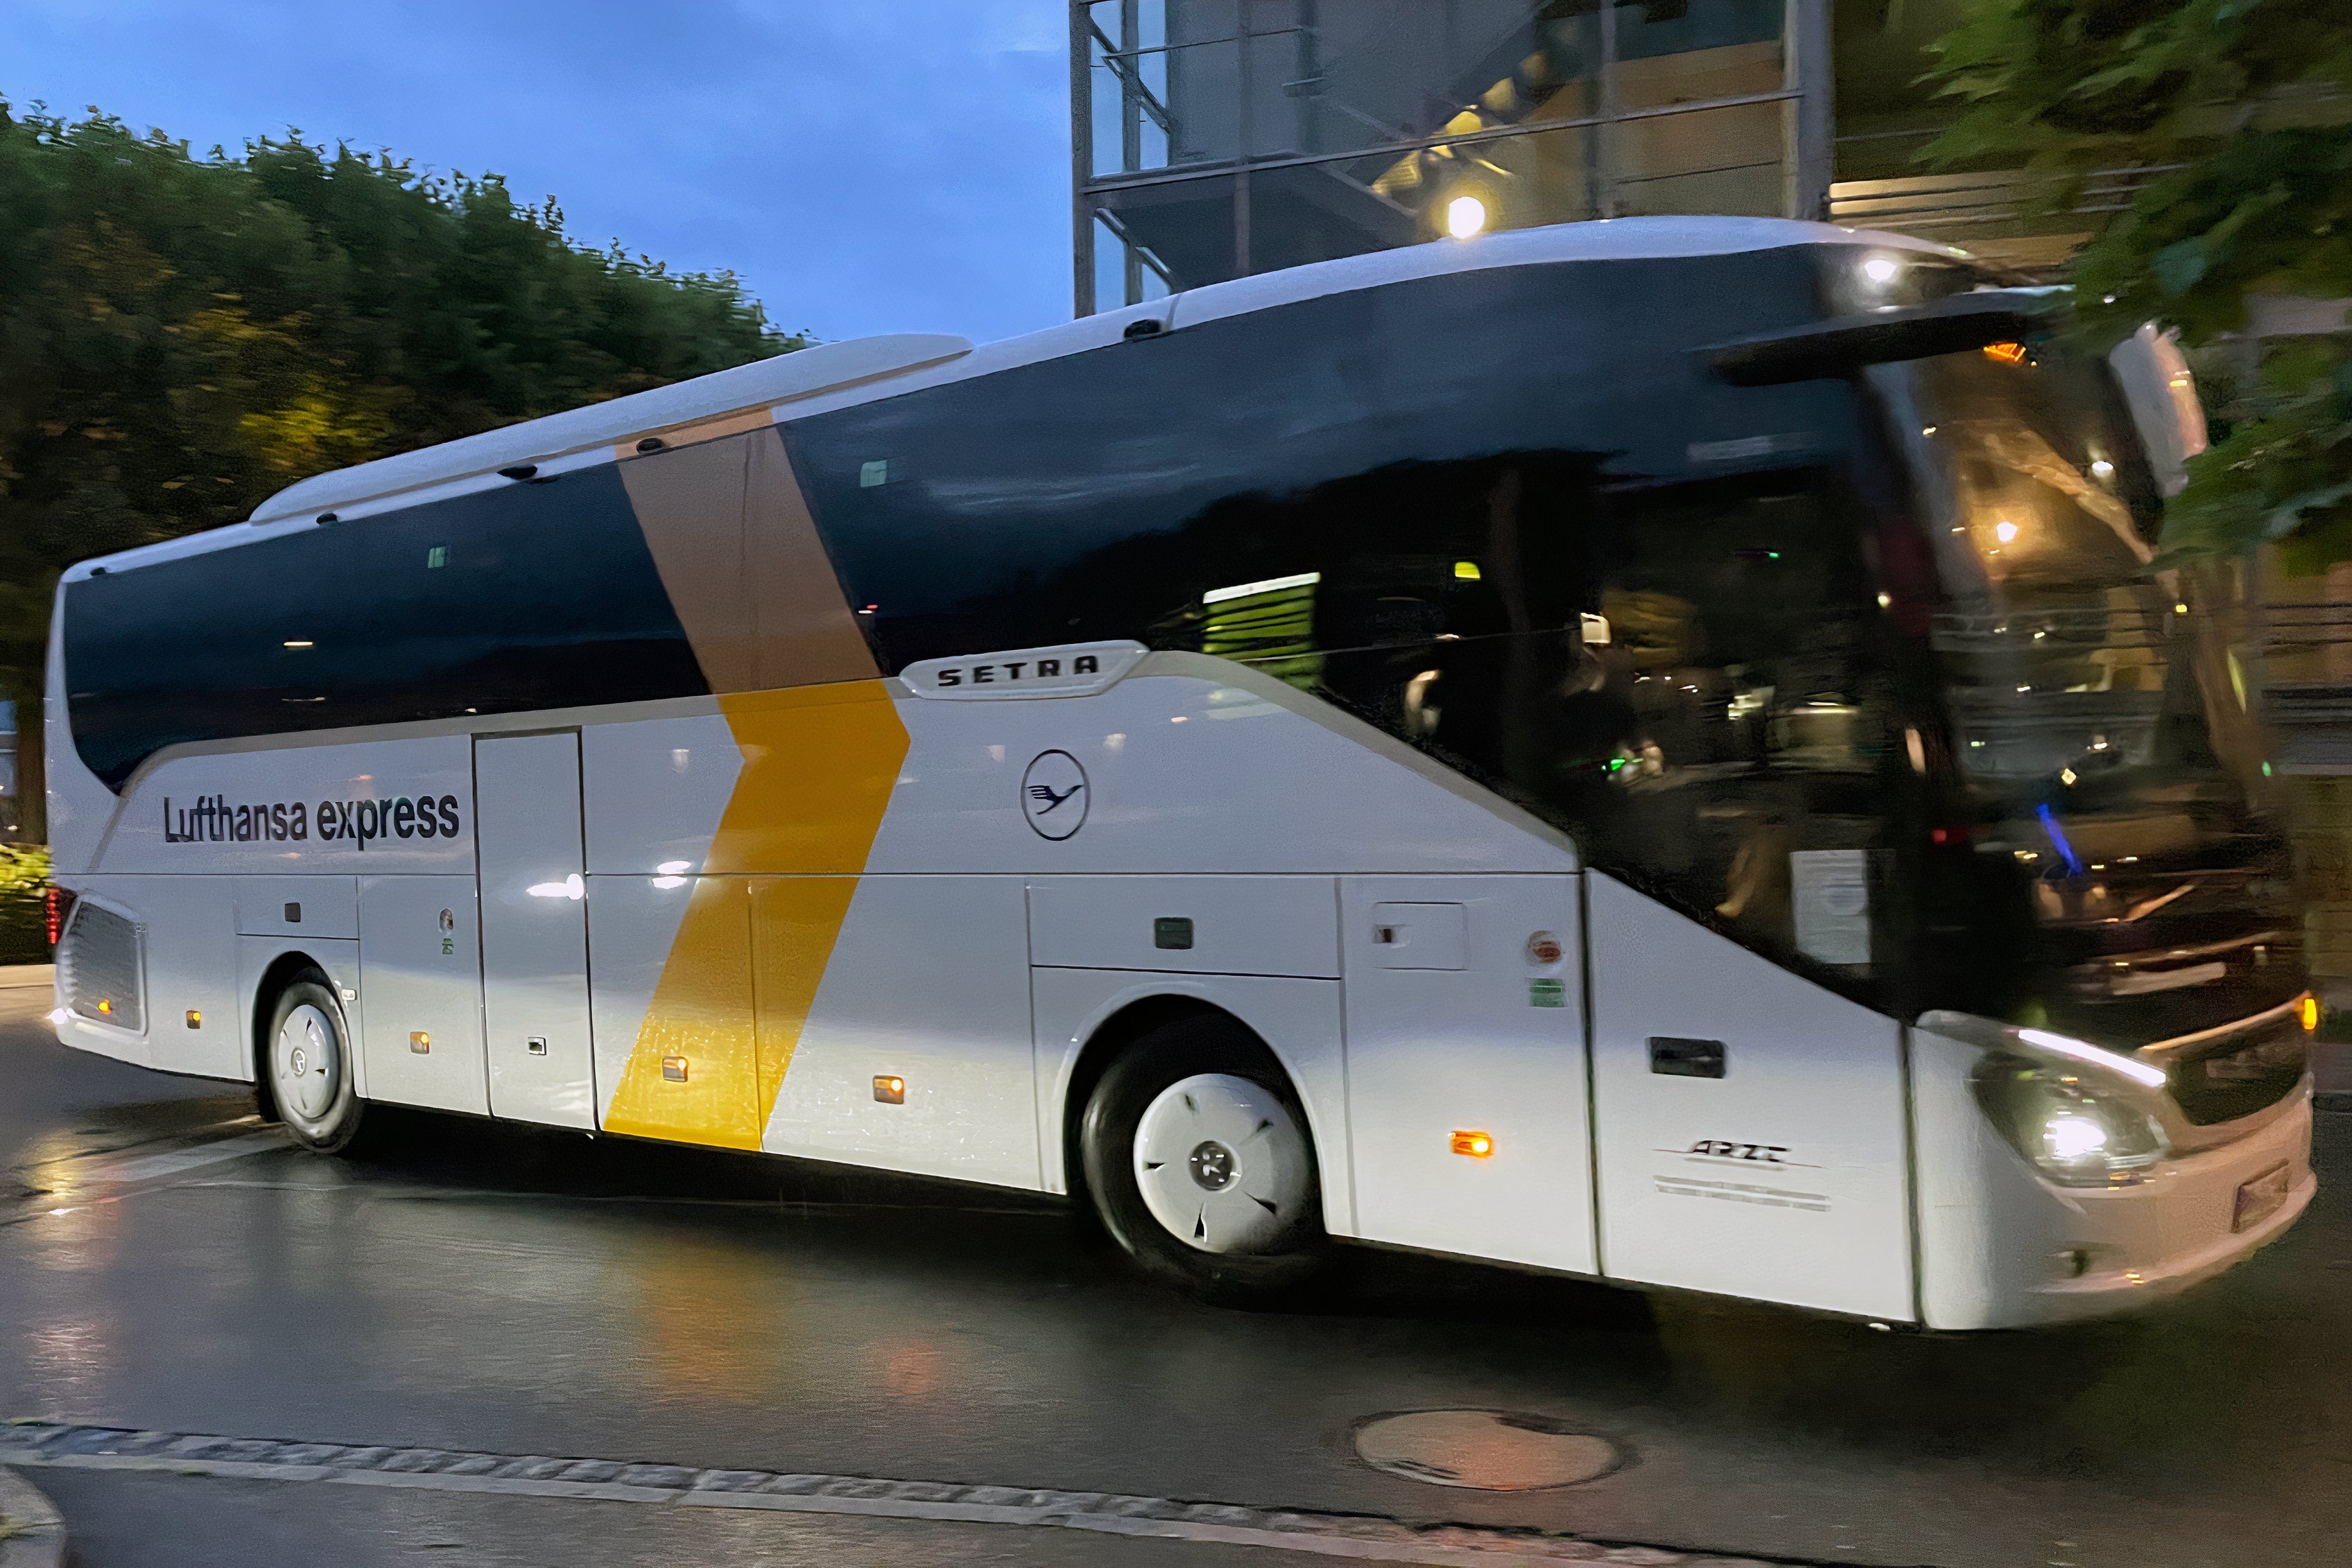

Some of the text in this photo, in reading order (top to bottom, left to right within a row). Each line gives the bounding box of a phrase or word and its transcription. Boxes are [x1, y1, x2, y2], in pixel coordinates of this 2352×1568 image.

[938, 655, 1098, 686] SETRA
[164, 794, 459, 851] Lufthansa express
